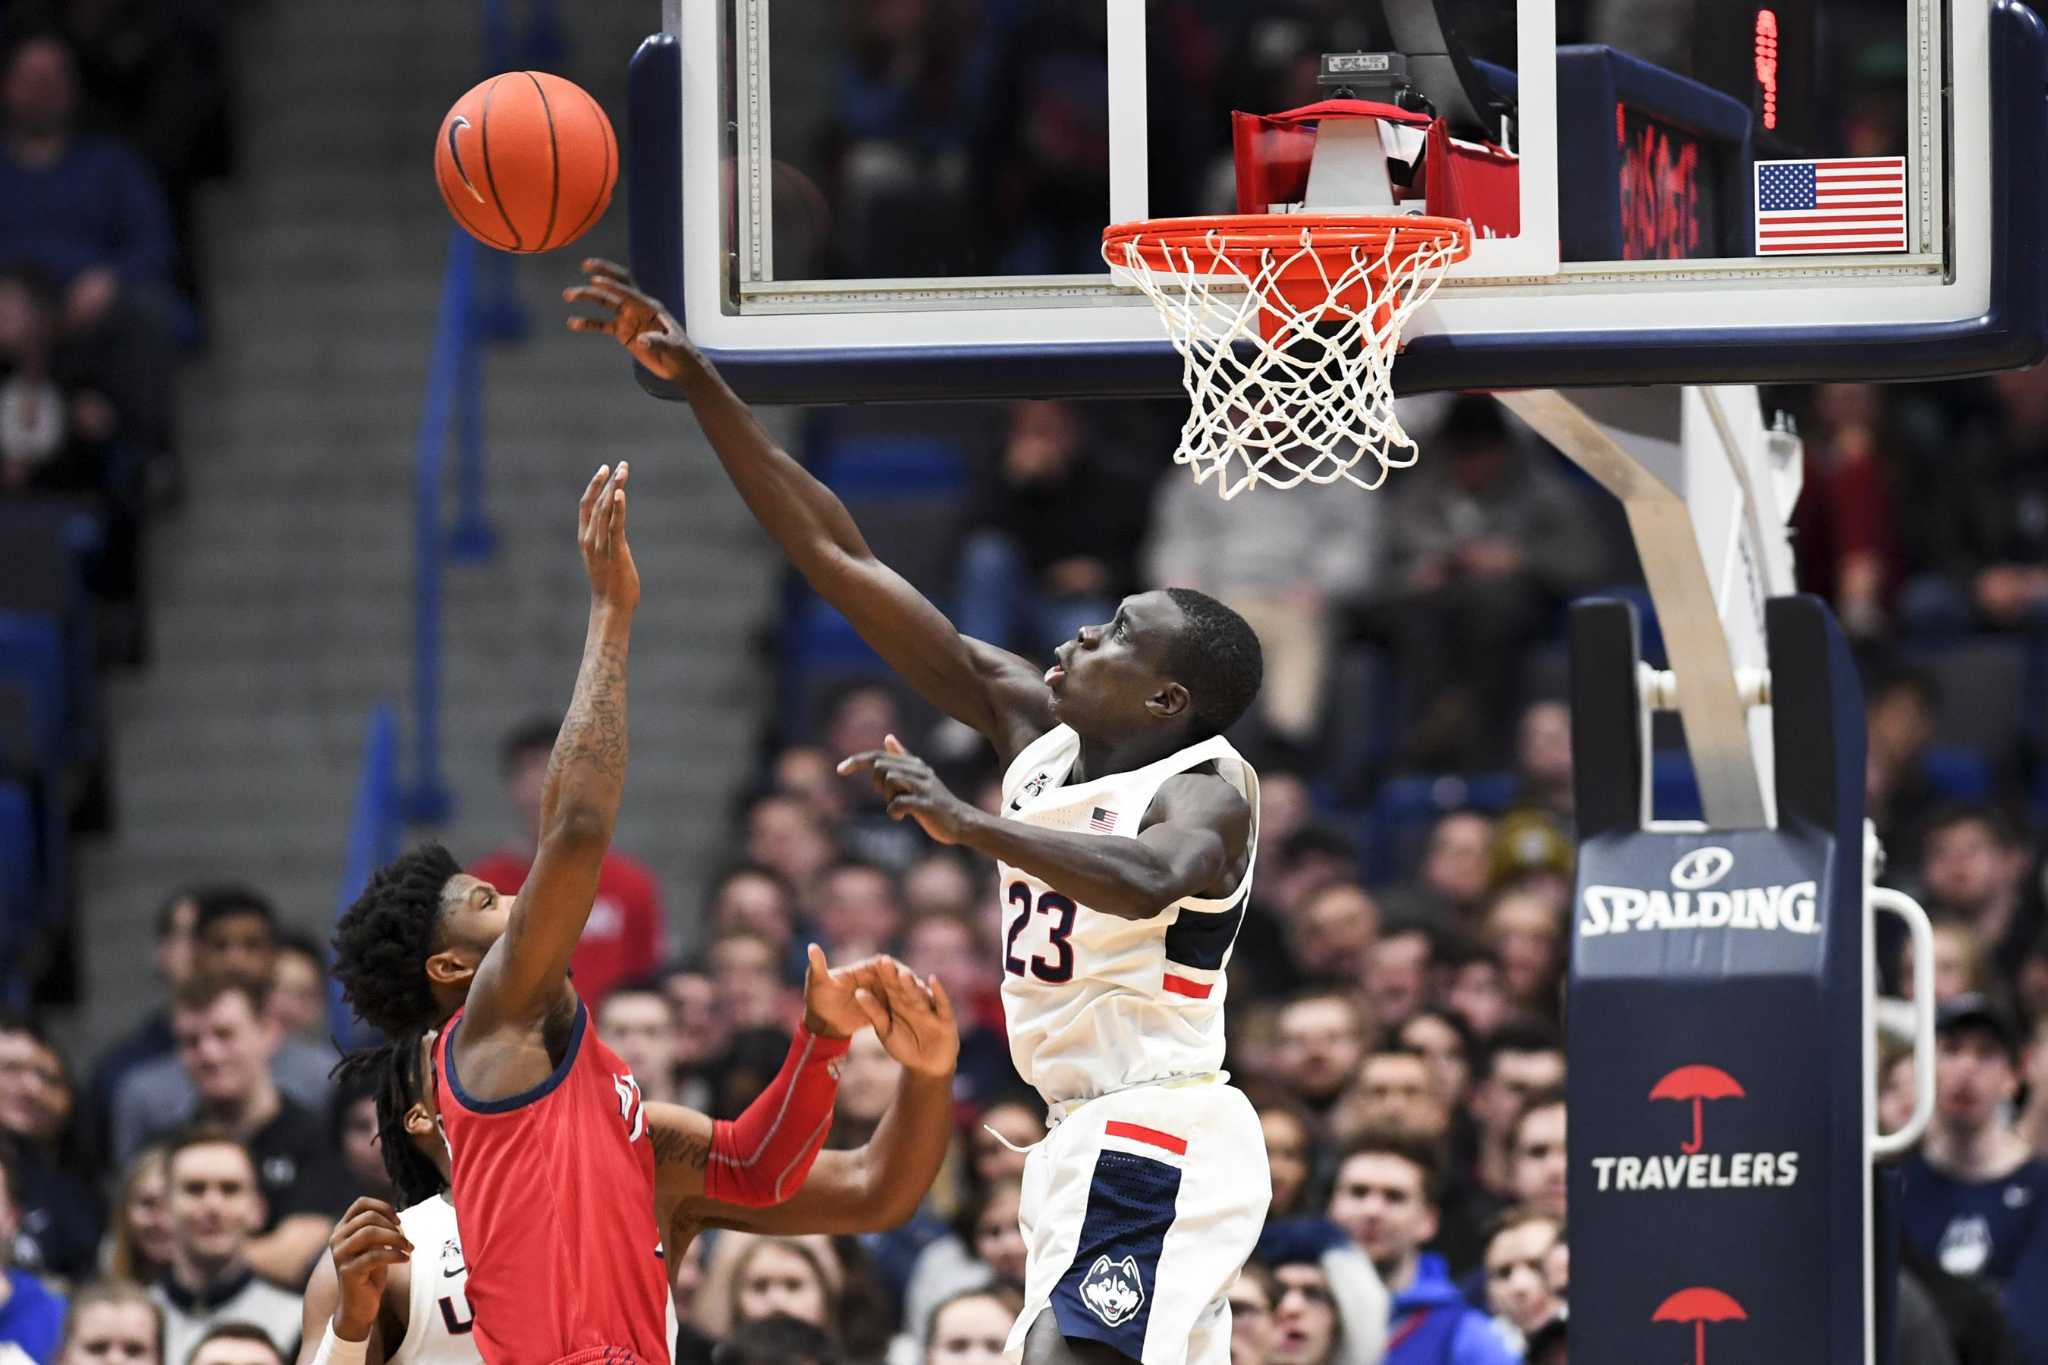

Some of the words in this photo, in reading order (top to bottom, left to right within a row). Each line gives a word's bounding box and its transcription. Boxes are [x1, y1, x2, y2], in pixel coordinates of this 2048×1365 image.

[1005, 880, 1077, 984] 23
[1580, 881, 1821, 937] SPALDING
[1591, 1151, 1799, 1191] TRAVELERS
